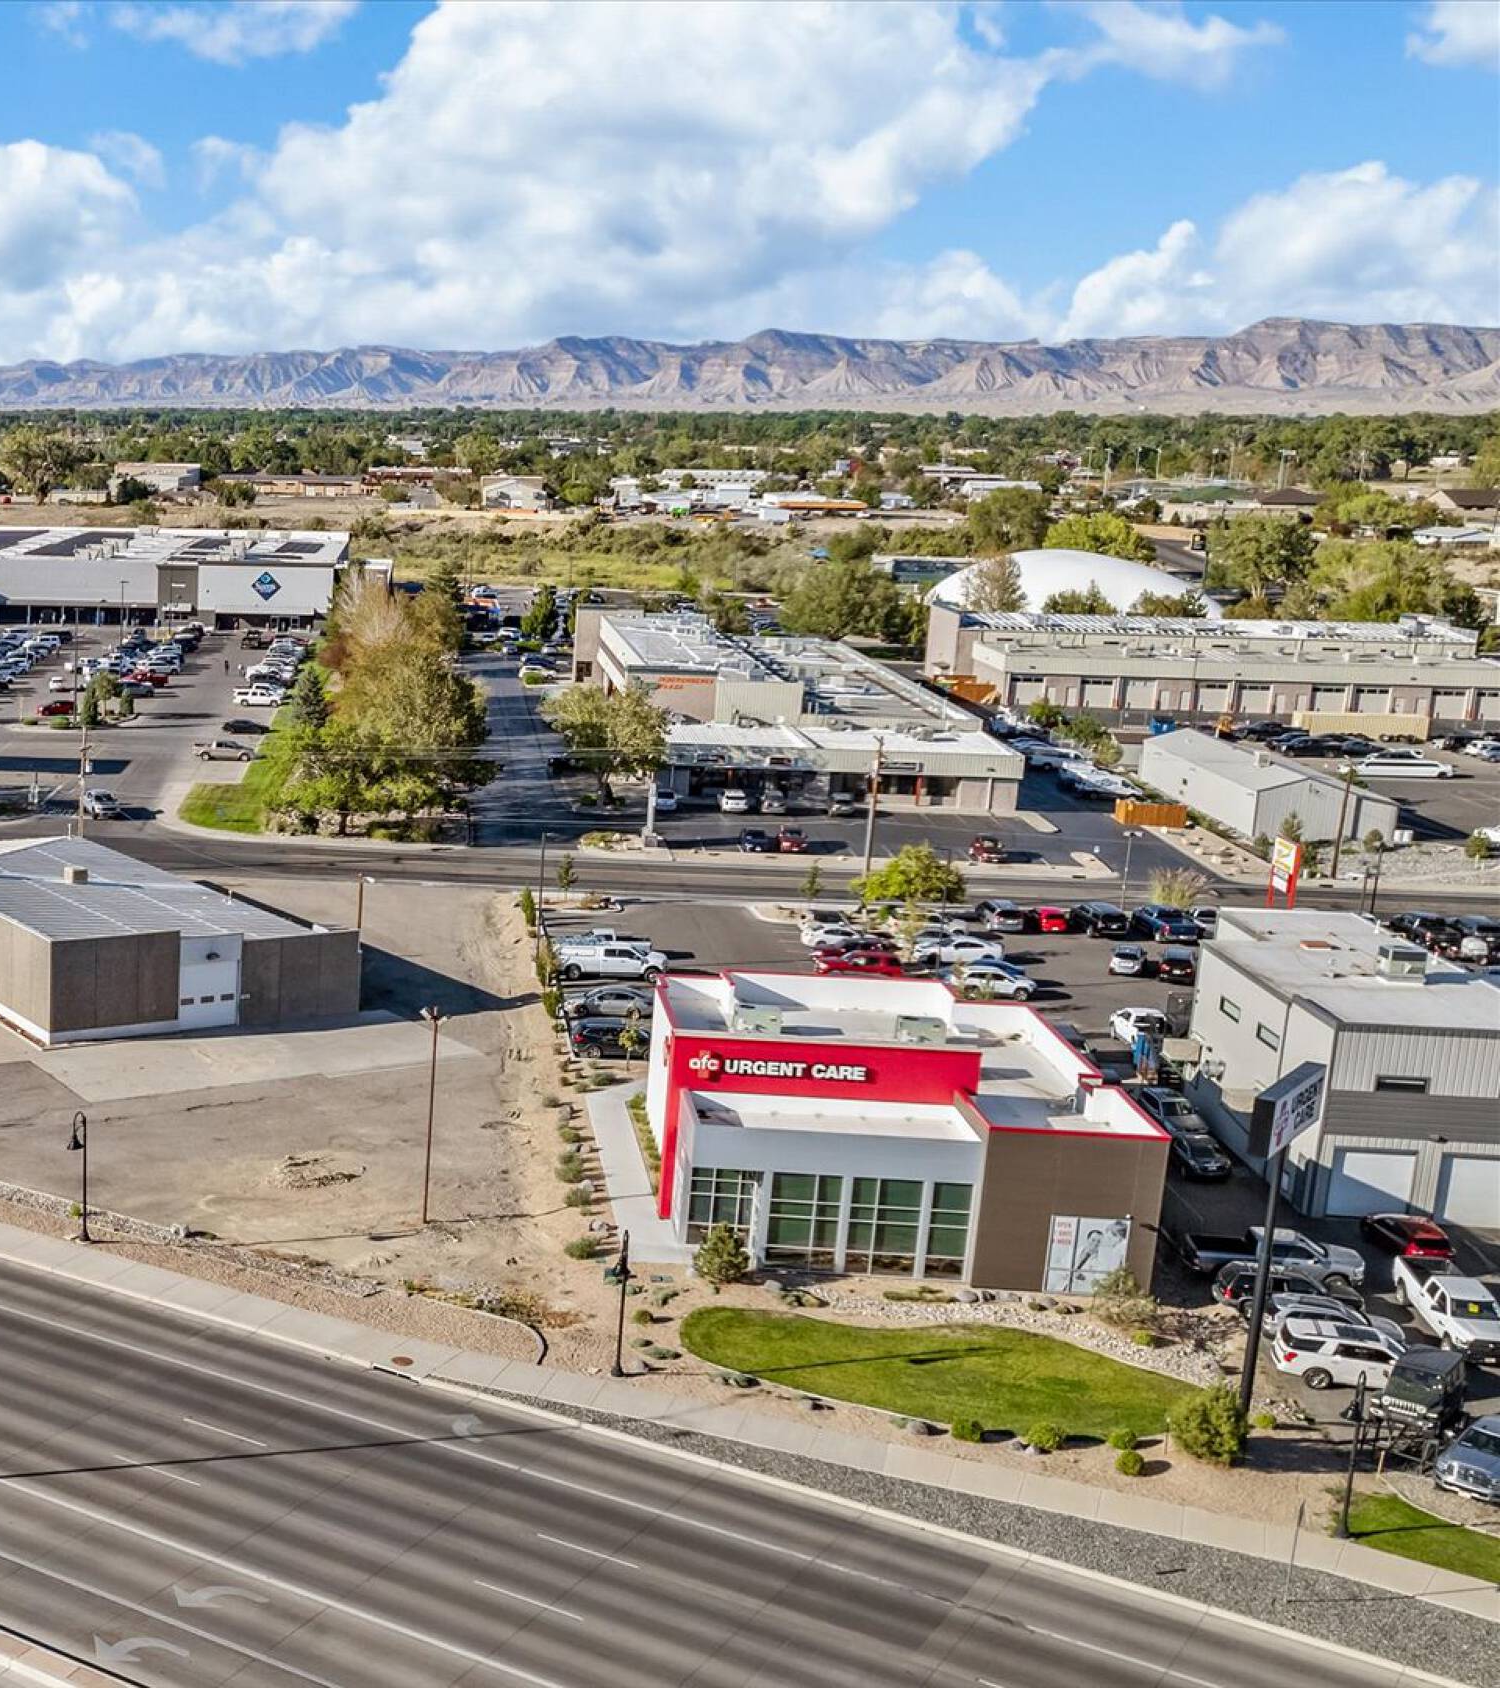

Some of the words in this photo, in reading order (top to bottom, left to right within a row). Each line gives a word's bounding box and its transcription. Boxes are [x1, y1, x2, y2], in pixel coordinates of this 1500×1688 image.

[688, 1054, 720, 1070] afc
[723, 1059, 807, 1078] URGENT
[811, 1063, 868, 1081] CARE
[1291, 1077, 1324, 1114] URGENT
[1293, 1100, 1315, 1129] CARE
